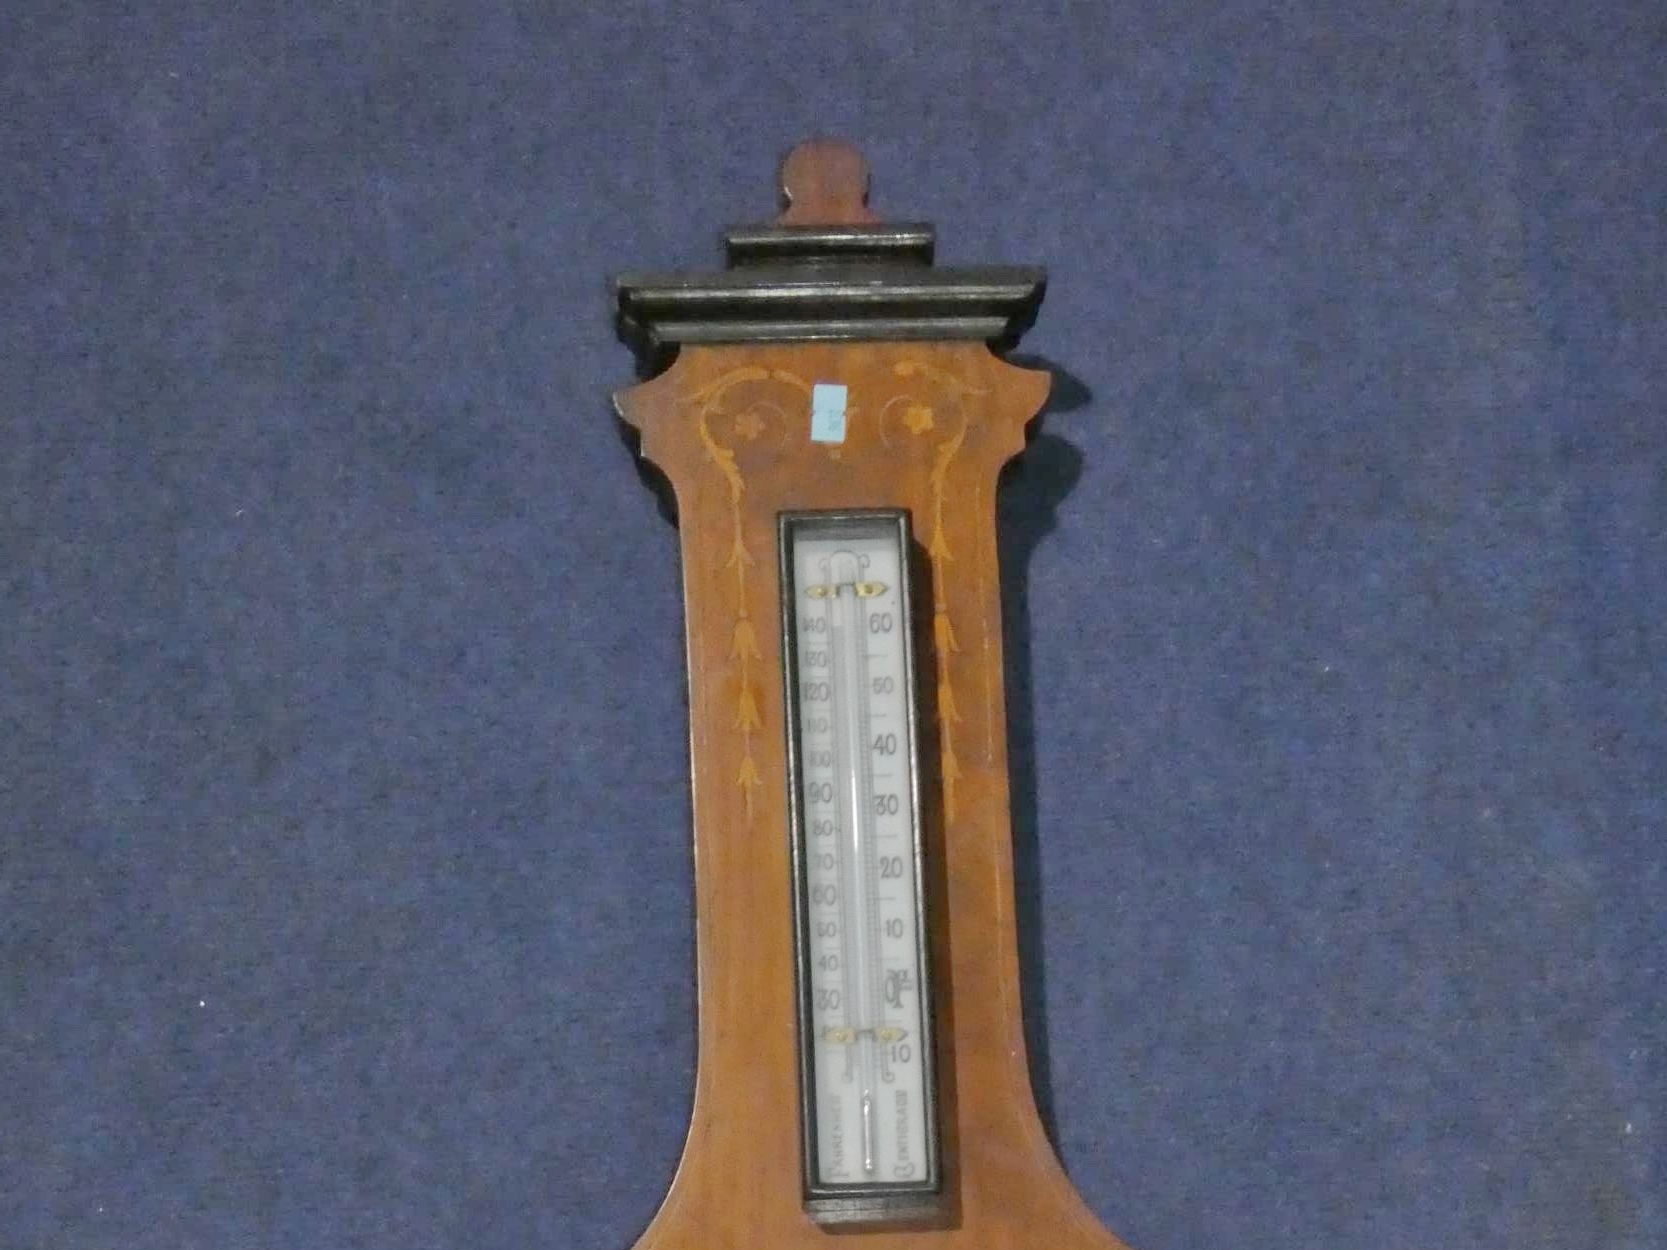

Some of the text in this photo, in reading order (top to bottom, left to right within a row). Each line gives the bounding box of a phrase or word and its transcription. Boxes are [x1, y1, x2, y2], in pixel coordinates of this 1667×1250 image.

[869, 613, 892, 633] 60
[804, 682, 829, 701] 120
[873, 677, 893, 694] 50
[873, 734, 897, 756] 40
[808, 782, 832, 803] 90
[875, 795, 899, 815] 30
[880, 857, 903, 878] 20
[885, 919, 903, 938] 10
[818, 955, 838, 971] 40
[817, 989, 839, 1010] 30
[892, 1044, 911, 1063] 10
